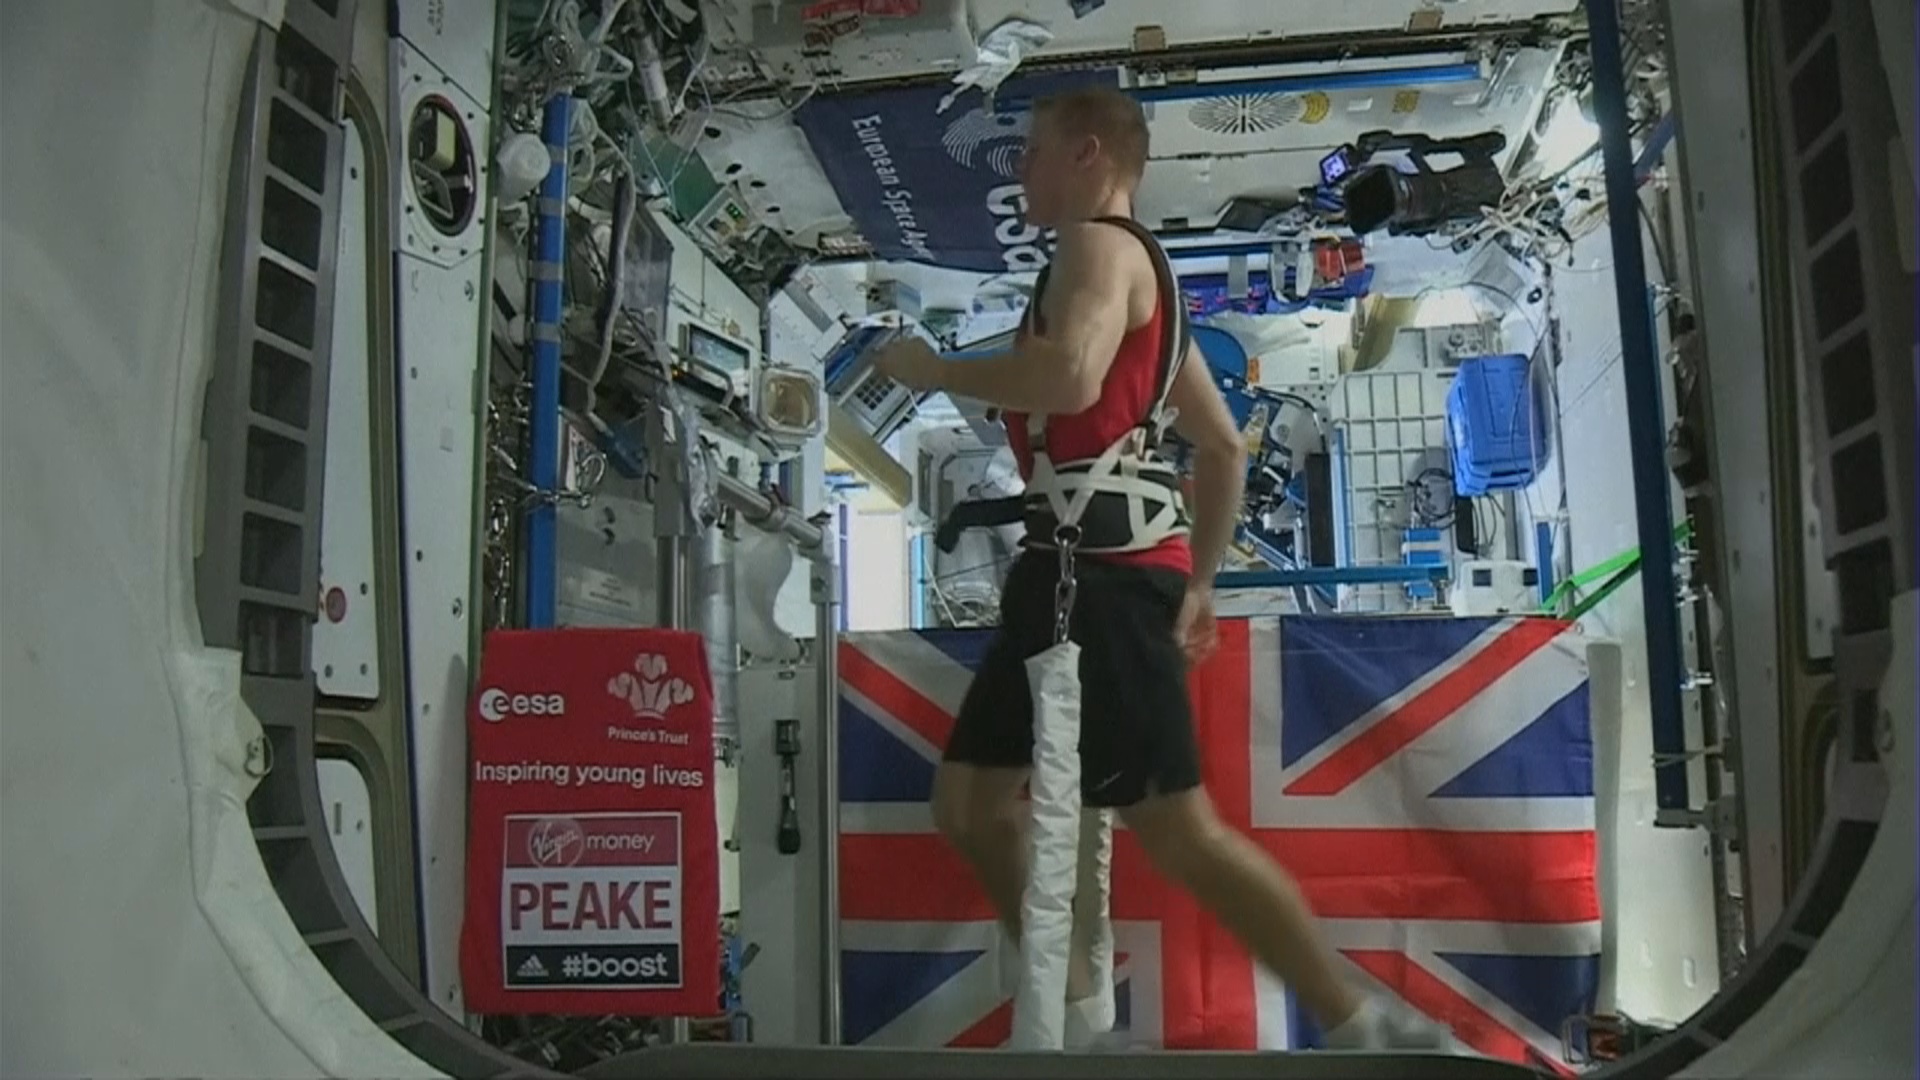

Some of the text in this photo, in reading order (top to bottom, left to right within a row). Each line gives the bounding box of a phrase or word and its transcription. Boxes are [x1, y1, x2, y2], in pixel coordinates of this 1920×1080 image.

[852, 114, 900, 185] European
[882, 189, 917, 228] Space
[986, 184, 1056, 271] esa
[607, 726, 690, 745] Prince's Trust
[475, 760, 704, 789] Inspiring young lives
[531, 822, 655, 864] Virgin money
[510, 880, 673, 931] PEAKE
[561, 952, 669, 978] #boost
